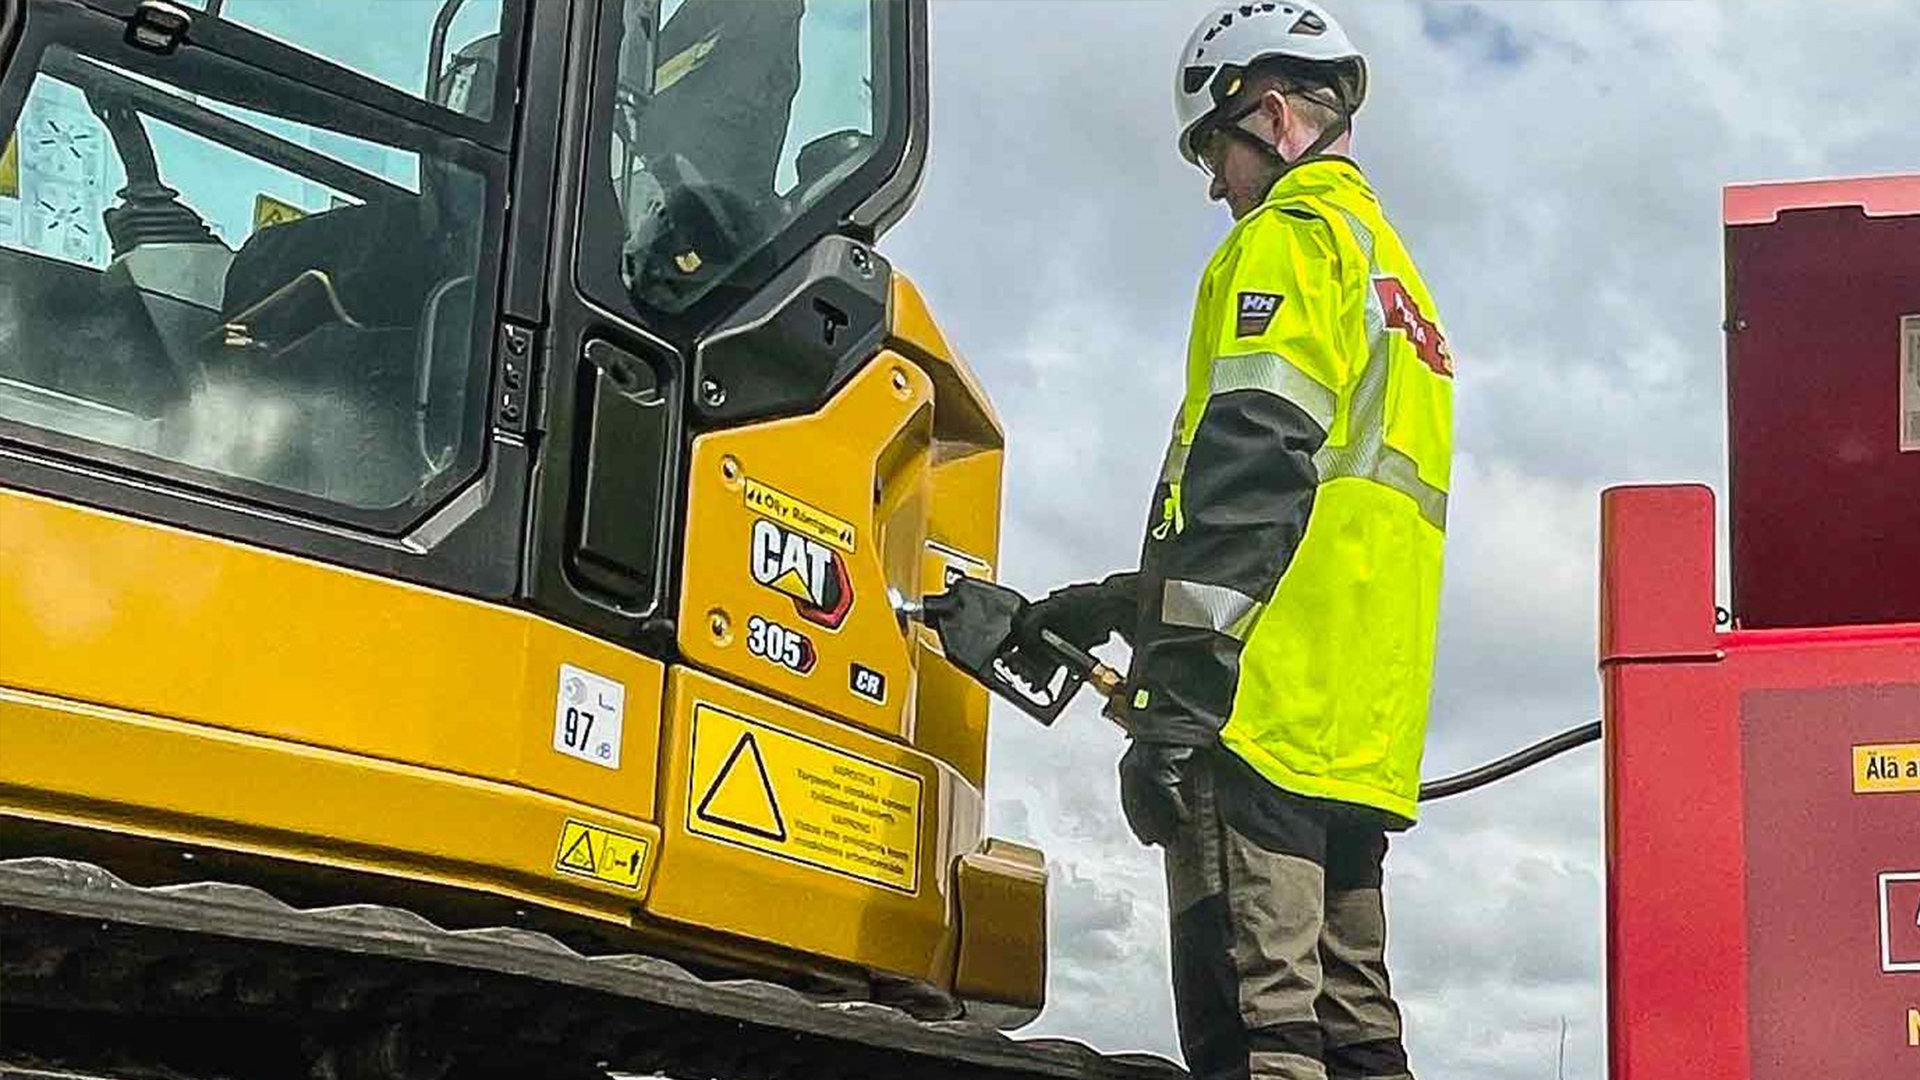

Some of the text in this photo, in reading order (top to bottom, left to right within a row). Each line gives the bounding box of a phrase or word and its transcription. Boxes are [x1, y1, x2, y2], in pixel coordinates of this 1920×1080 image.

[753, 519, 832, 606] CAT
[749, 617, 802, 668] 305
[856, 670, 880, 694] CR
[564, 706, 595, 752] 97
[1866, 750, 1920, 780] Älä a
